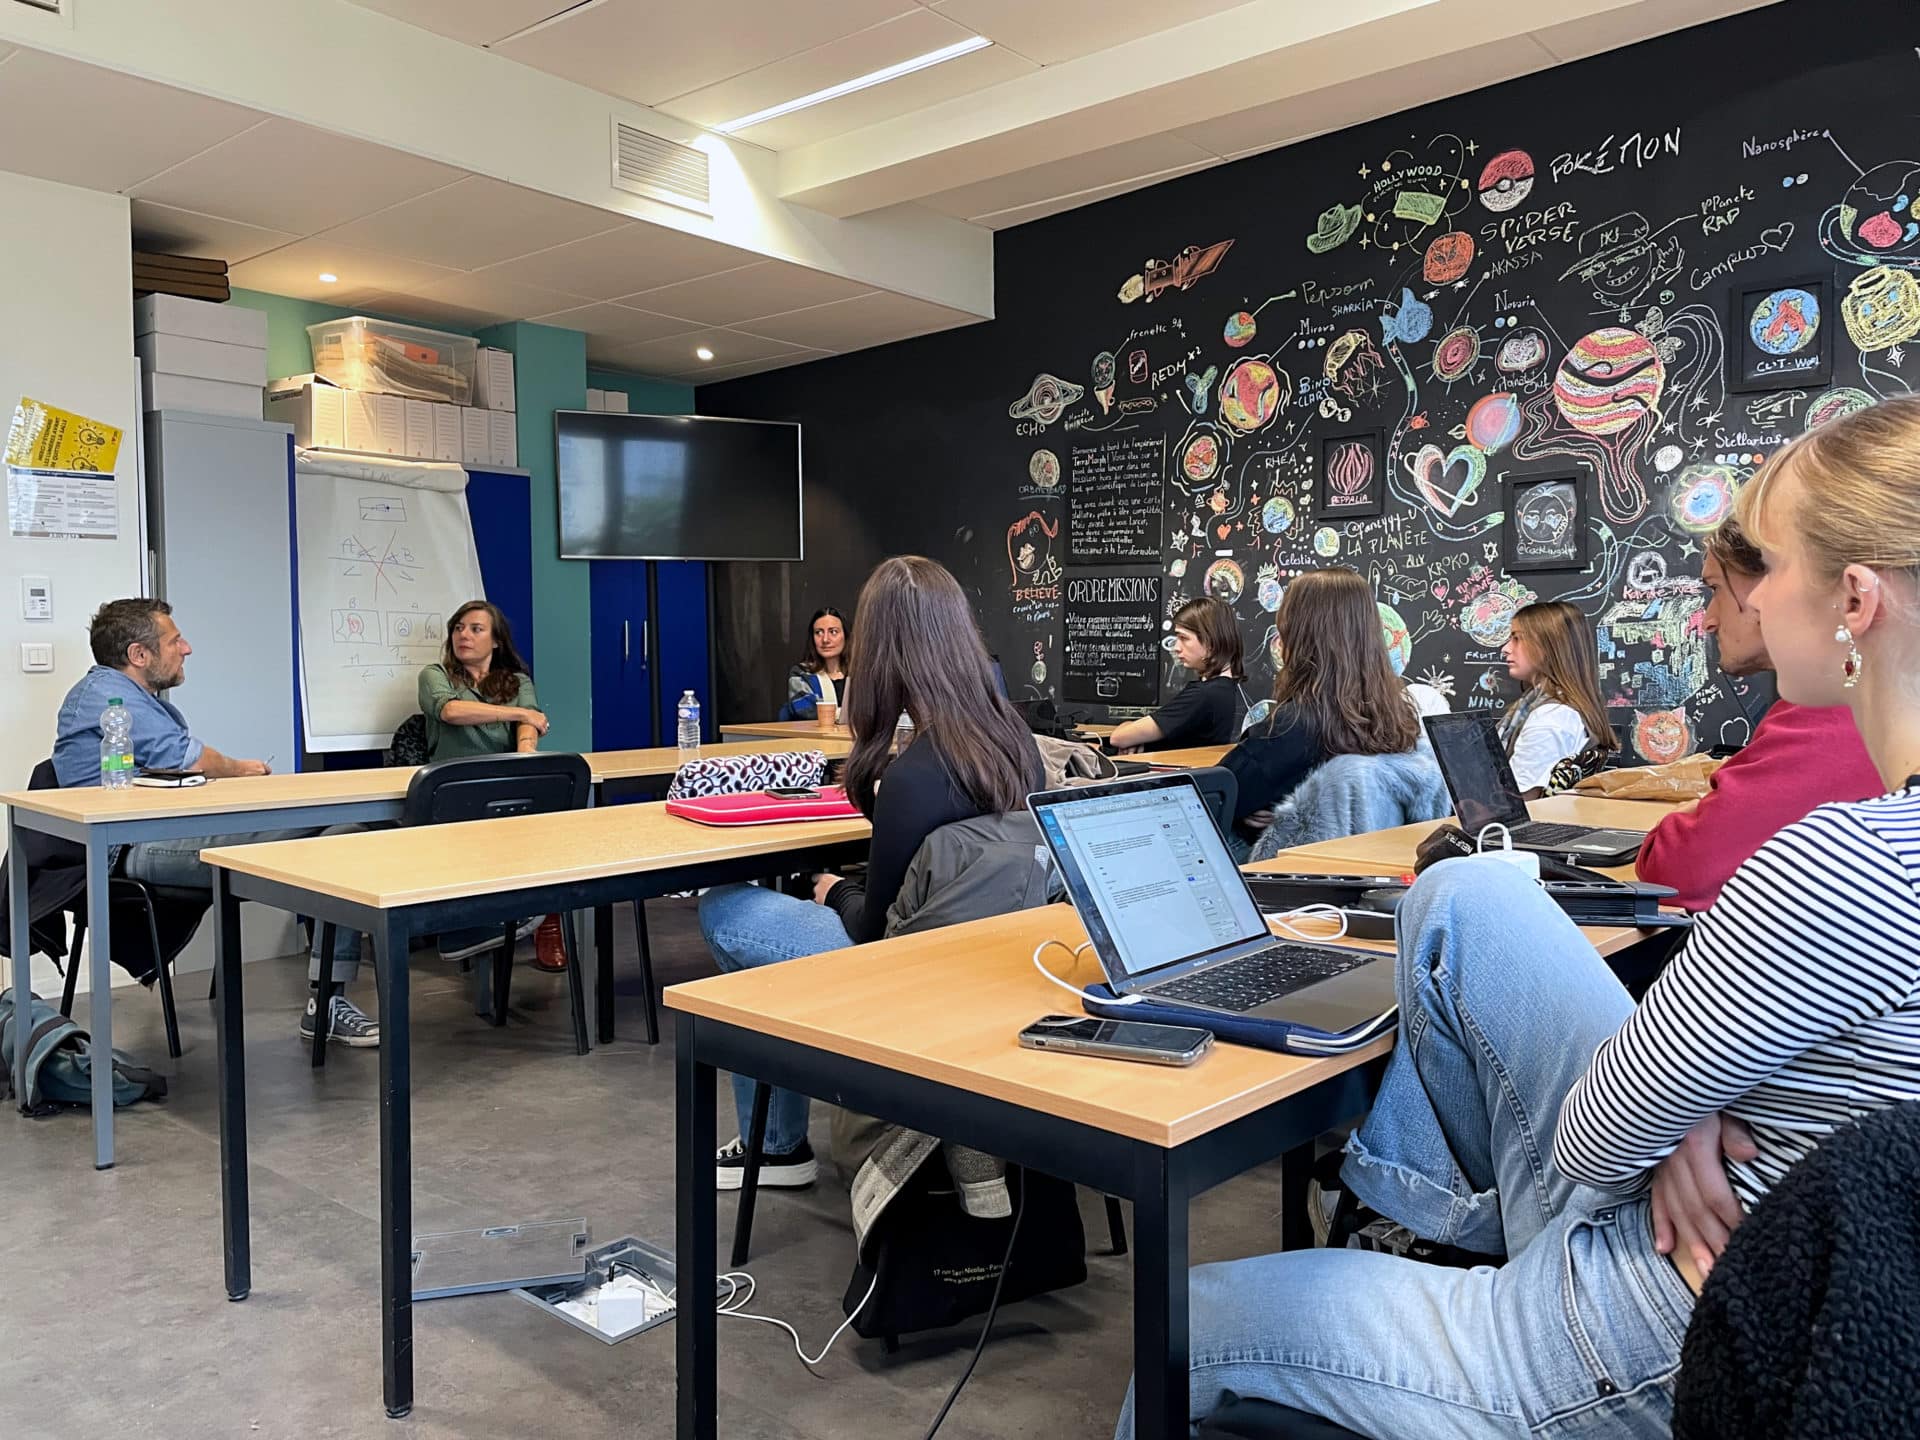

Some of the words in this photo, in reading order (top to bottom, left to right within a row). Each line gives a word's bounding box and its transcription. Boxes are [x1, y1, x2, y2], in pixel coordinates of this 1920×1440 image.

[1550, 127, 1680, 183] POKÉMON
[1373, 165, 1442, 193] HOLLYWOOD
[1505, 221, 1579, 254] VERSE
[1016, 423, 1046, 436] ECHO
[1347, 540, 1362, 556] LA
[1427, 552, 1470, 579] KROKO
[1068, 579, 1107, 602] ORDRE
[1108, 578, 1158, 602] MISSIONS
[1468, 696, 1505, 709] NINO
